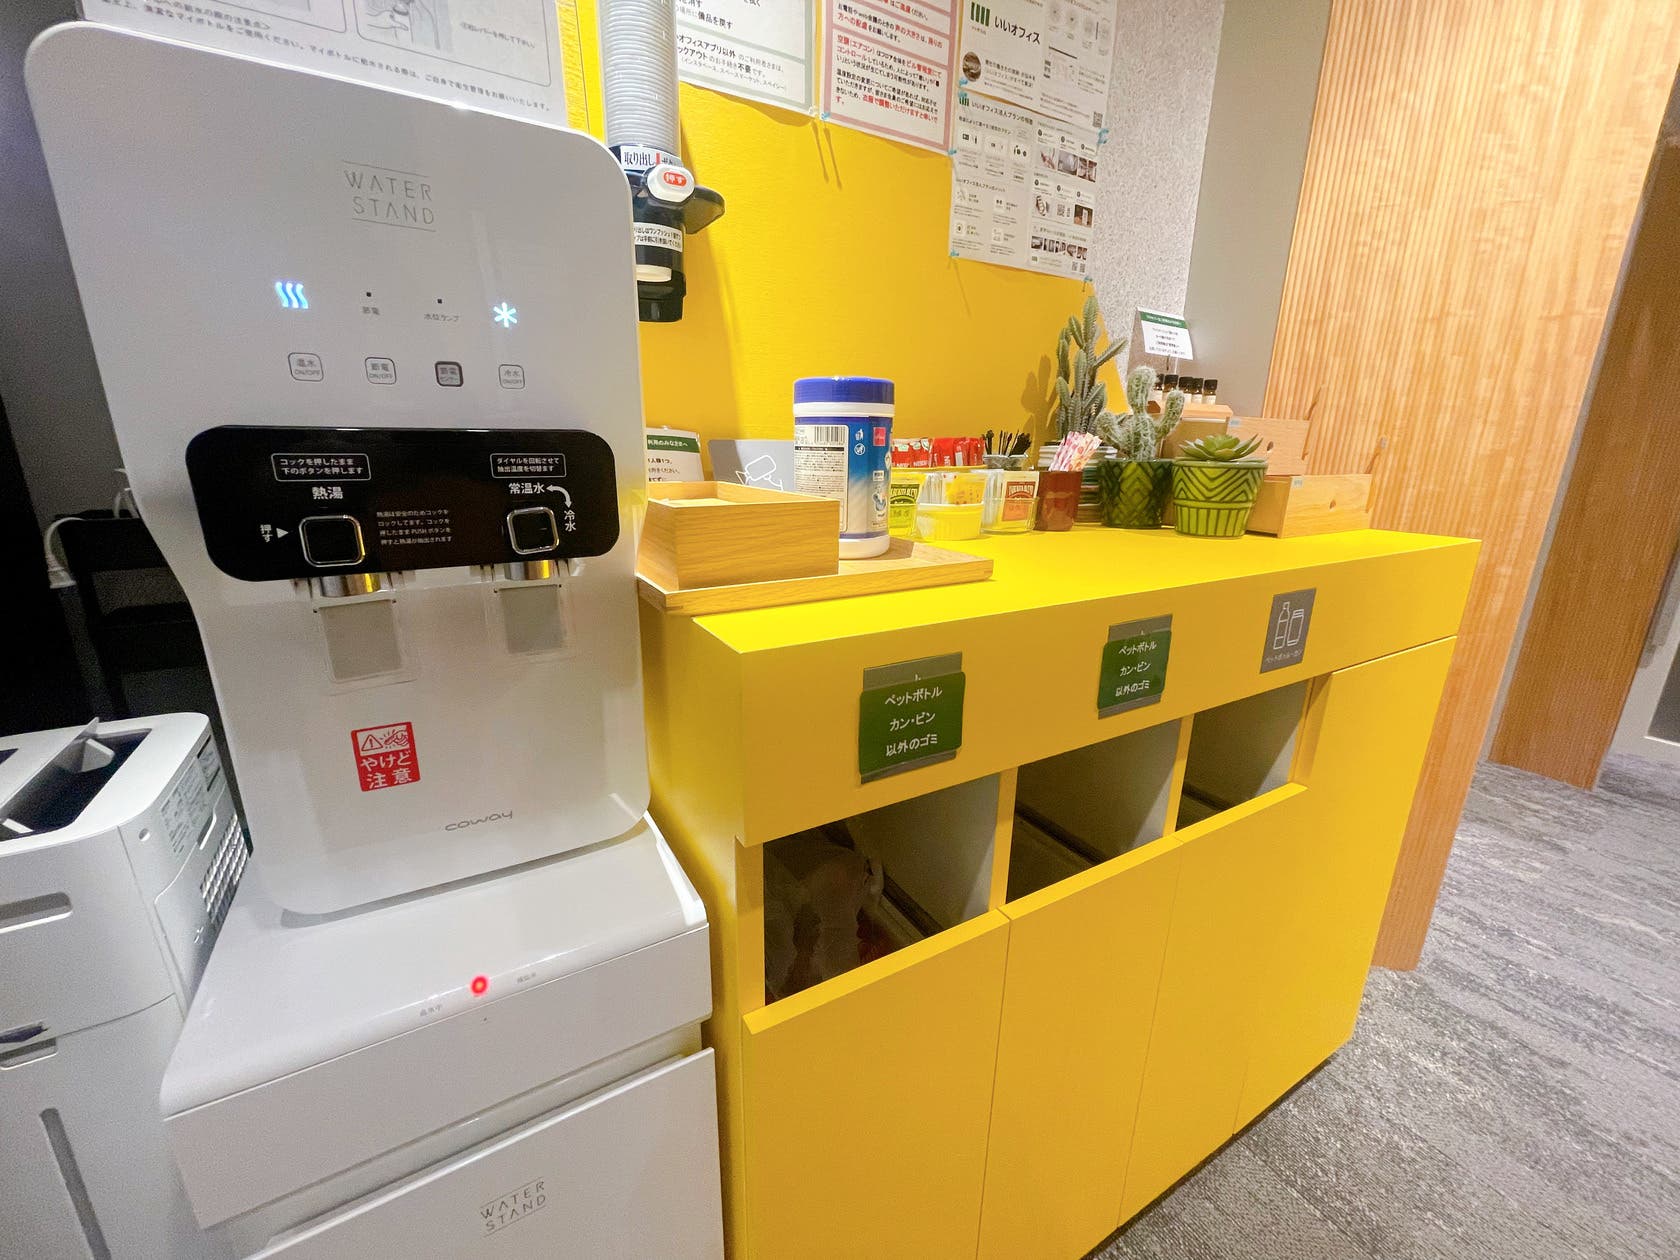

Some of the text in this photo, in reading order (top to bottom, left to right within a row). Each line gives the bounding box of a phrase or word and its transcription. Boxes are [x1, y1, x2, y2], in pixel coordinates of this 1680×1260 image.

[994, 15, 1041, 45] いいオフィス
[344, 170, 432, 201] WATER
[353, 196, 435, 225] STAND
[280, 458, 354, 466] コックを押したまま
[281, 467, 363, 475] 下のボタンを押します
[497, 457, 560, 465] ダイヤルを回転させて
[312, 486, 343, 500] 熱湯
[508, 482, 545, 494] 常温水
[564, 511, 576, 532] 冷水
[260, 524, 273, 543] 押す
[1119, 641, 1157, 656] ペットボトル
[885, 686, 943, 706] ペットボトル
[1115, 680, 1150, 697] 以外のゴミ
[885, 733, 938, 757] 以外のゴミ
[361, 750, 412, 772] やけど
[367, 768, 412, 789] 注意
[445, 810, 513, 832] coway
[480, 1181, 544, 1219] WATER
[485, 1195, 546, 1231] STAND
